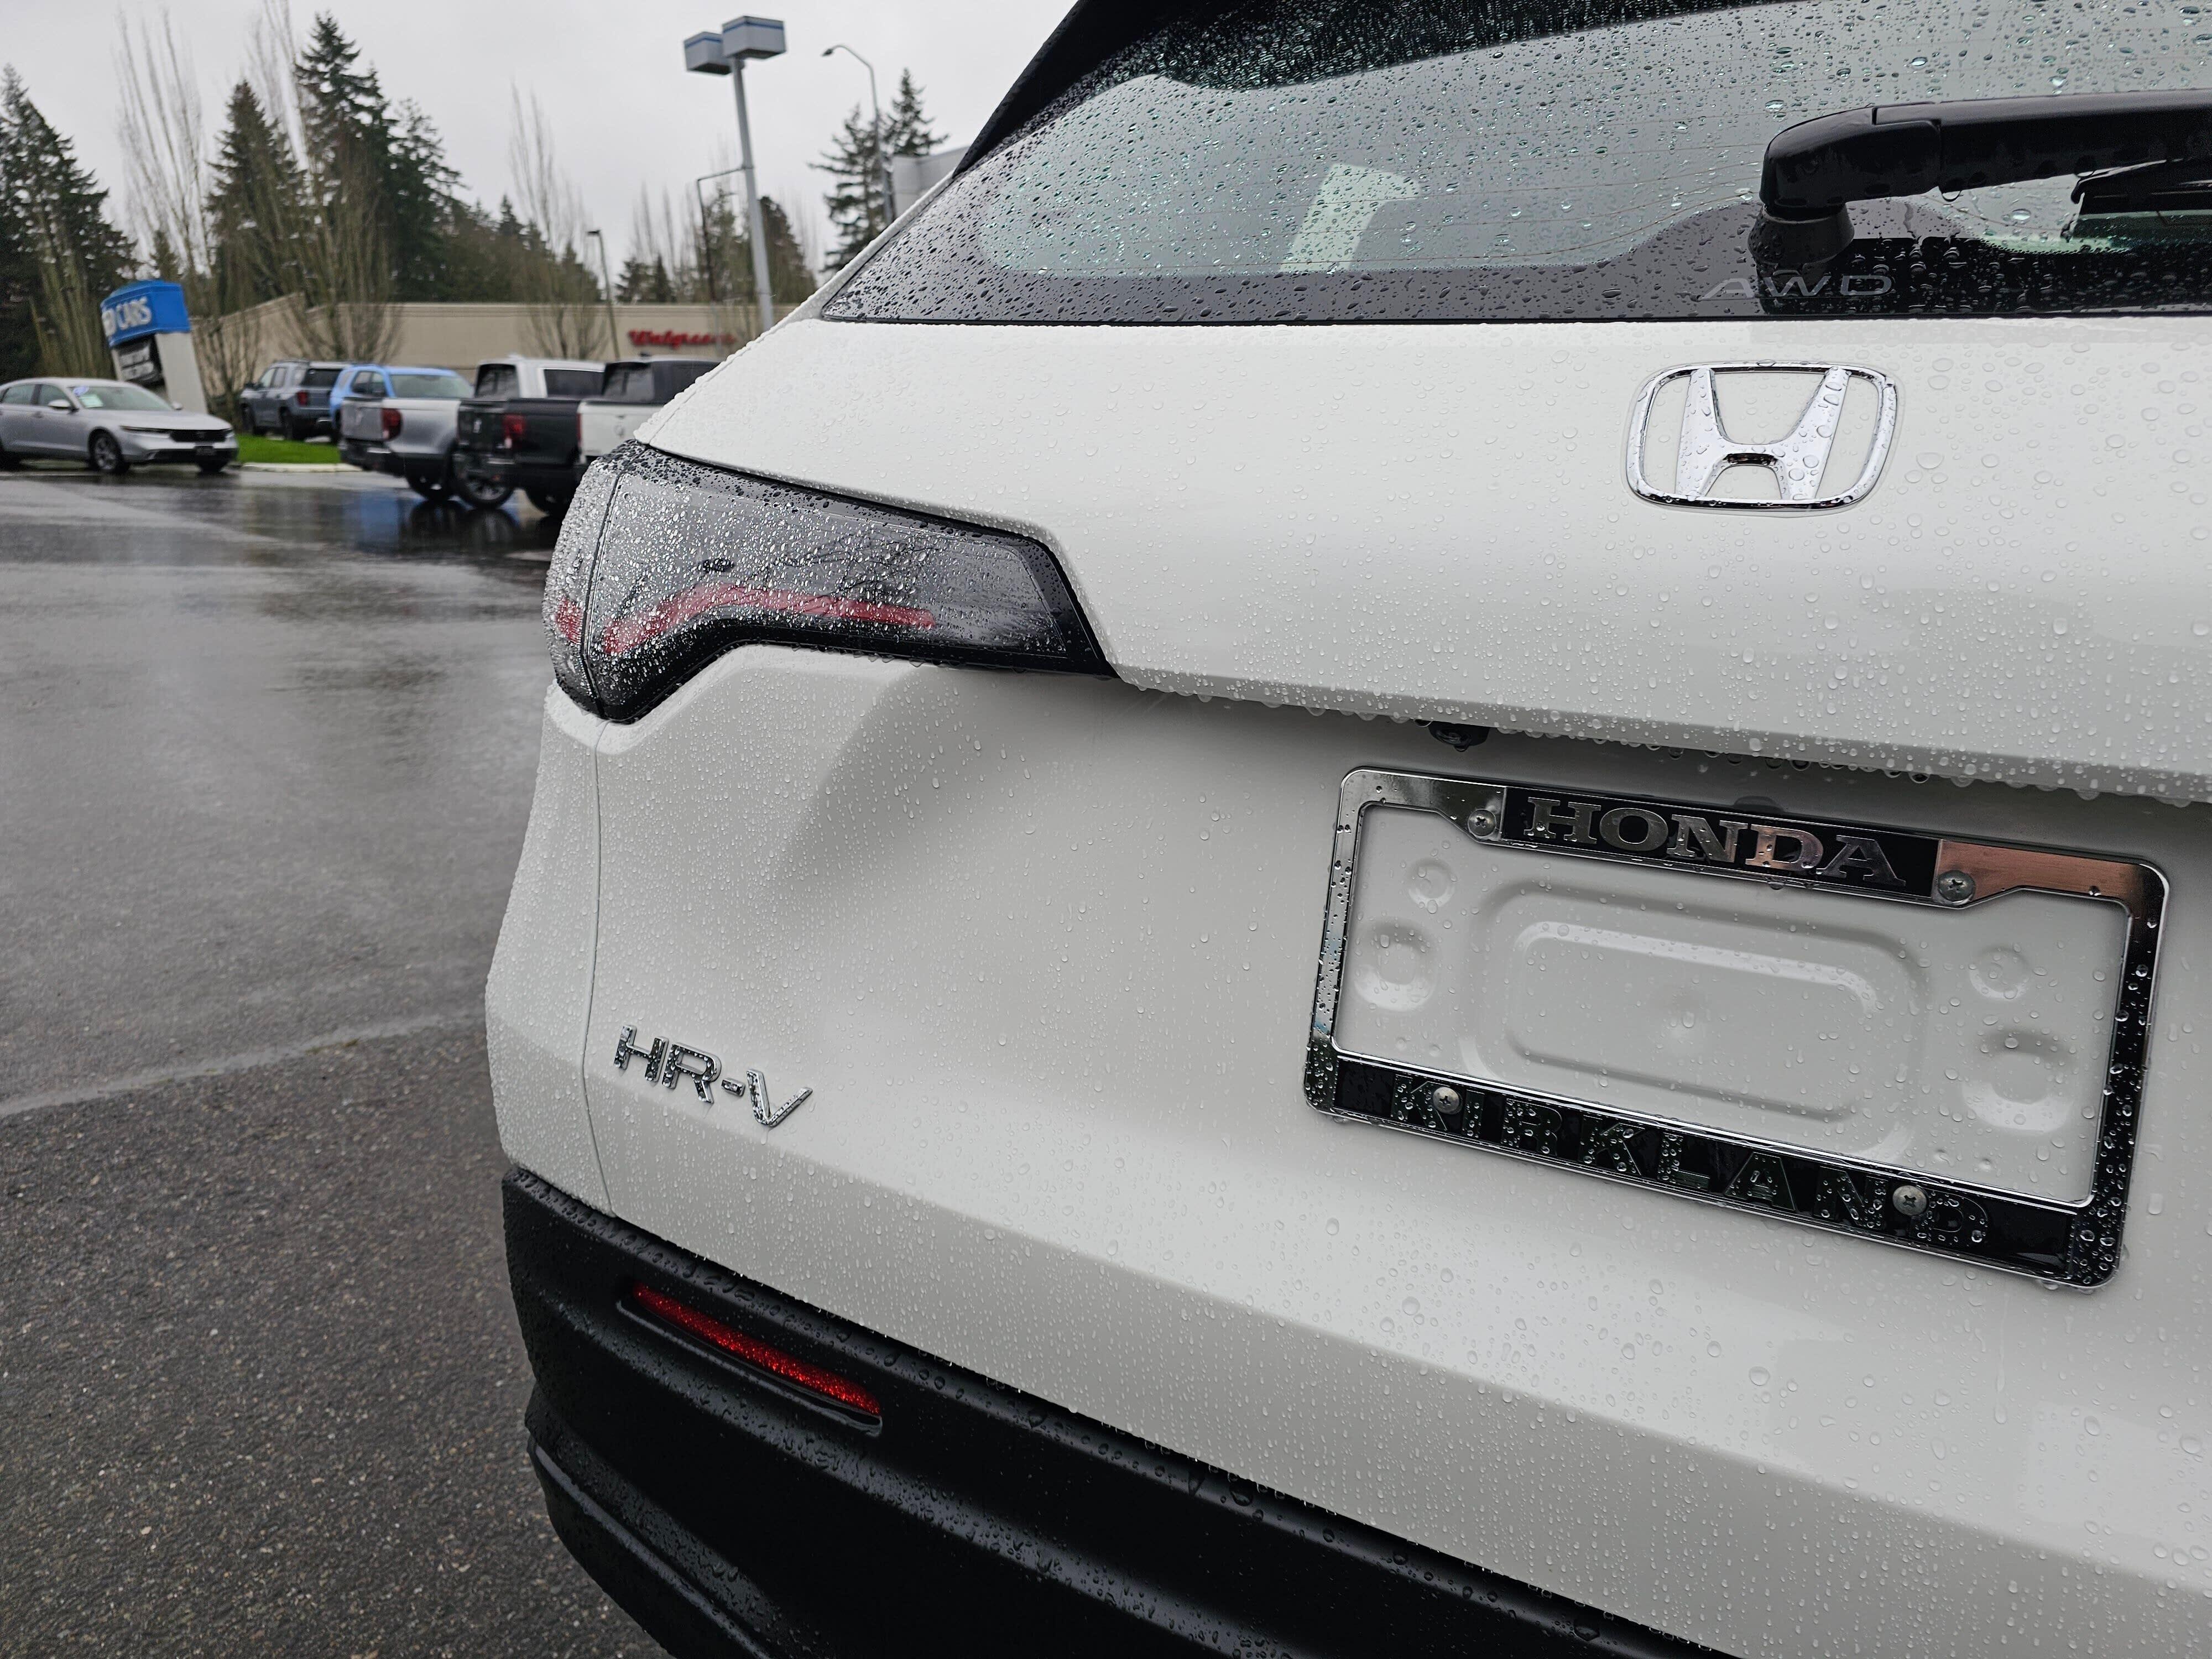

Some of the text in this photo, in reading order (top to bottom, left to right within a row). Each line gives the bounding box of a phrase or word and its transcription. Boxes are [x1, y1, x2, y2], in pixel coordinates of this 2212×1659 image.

[1700, 274, 1893, 300] AWD
[1522, 796, 1907, 886] HONDA
[613, 1024, 813, 1127] HR-V
[1389, 1073, 1990, 1249] KIRKLAND
